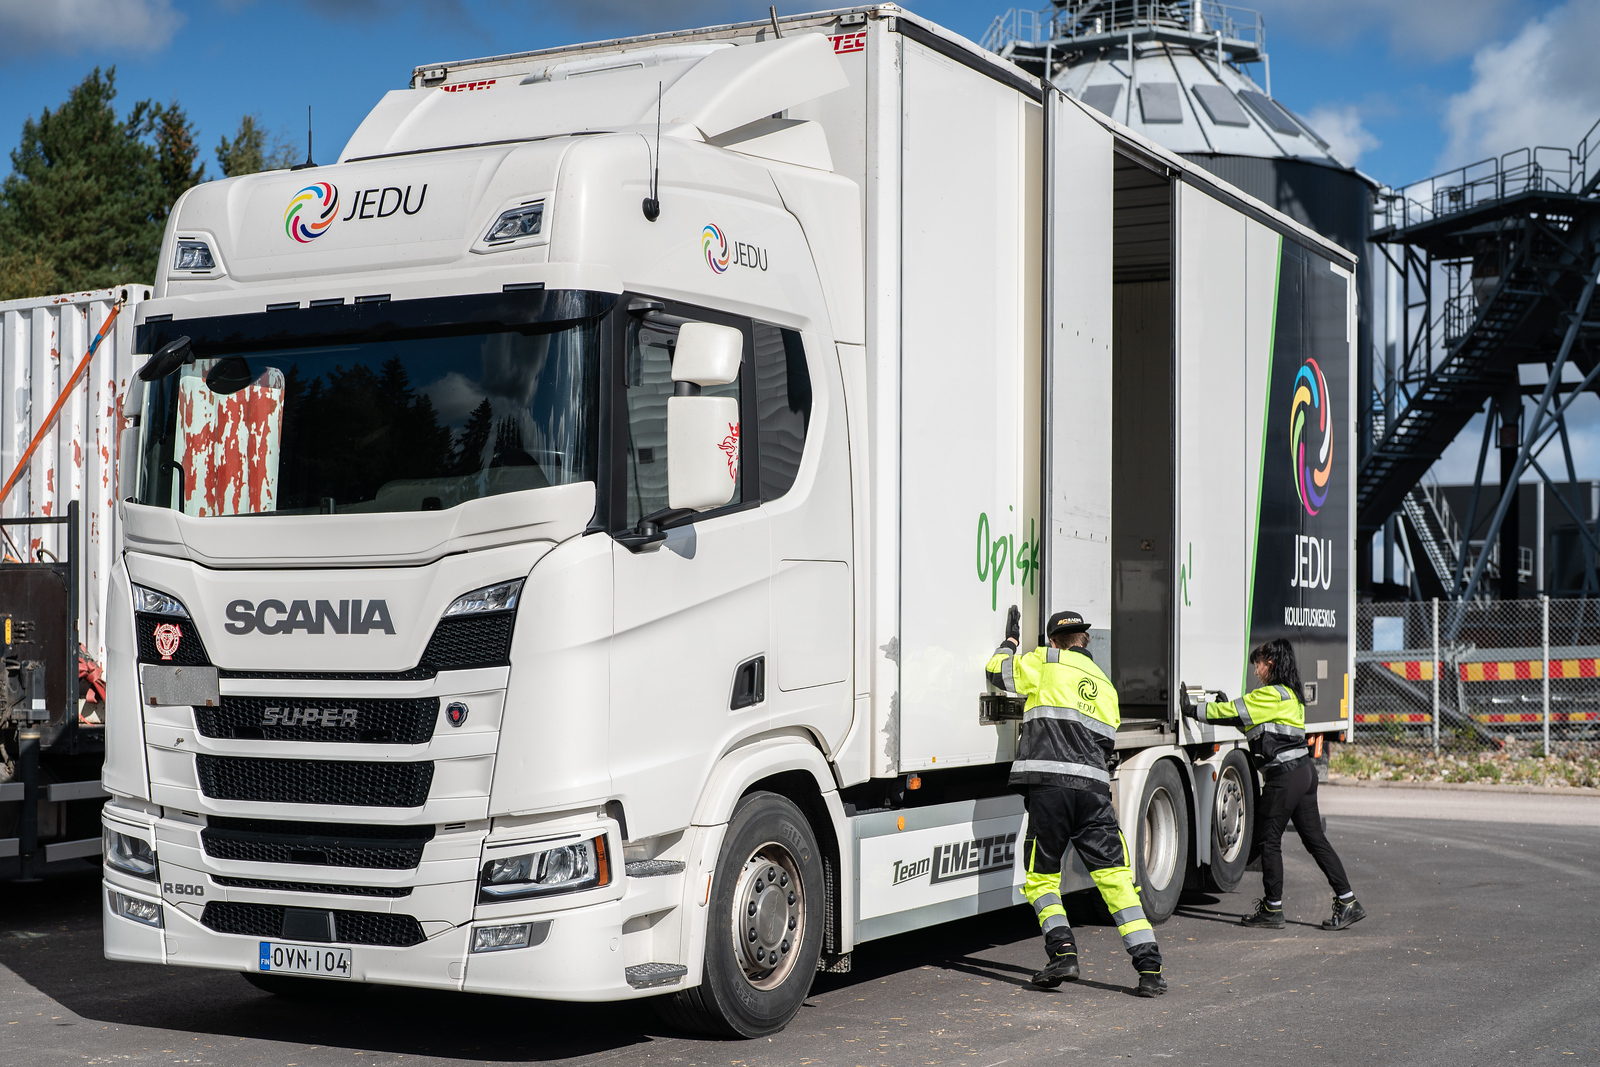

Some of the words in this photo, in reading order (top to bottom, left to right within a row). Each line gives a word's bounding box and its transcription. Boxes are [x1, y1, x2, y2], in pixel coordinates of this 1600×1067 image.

[343, 184, 428, 222] JEDU
[733, 241, 768, 271] JEDU
[1290, 534, 1332, 590] JEDU
[224, 599, 397, 635] SCANIA
[1284, 606, 1336, 628] KOULUTUSKESKUS
[262, 707, 358, 727] SUPER
[892, 858, 931, 886] Team
[260, 958, 270, 966] FIN
[273, 947, 347, 973] OVN-104
